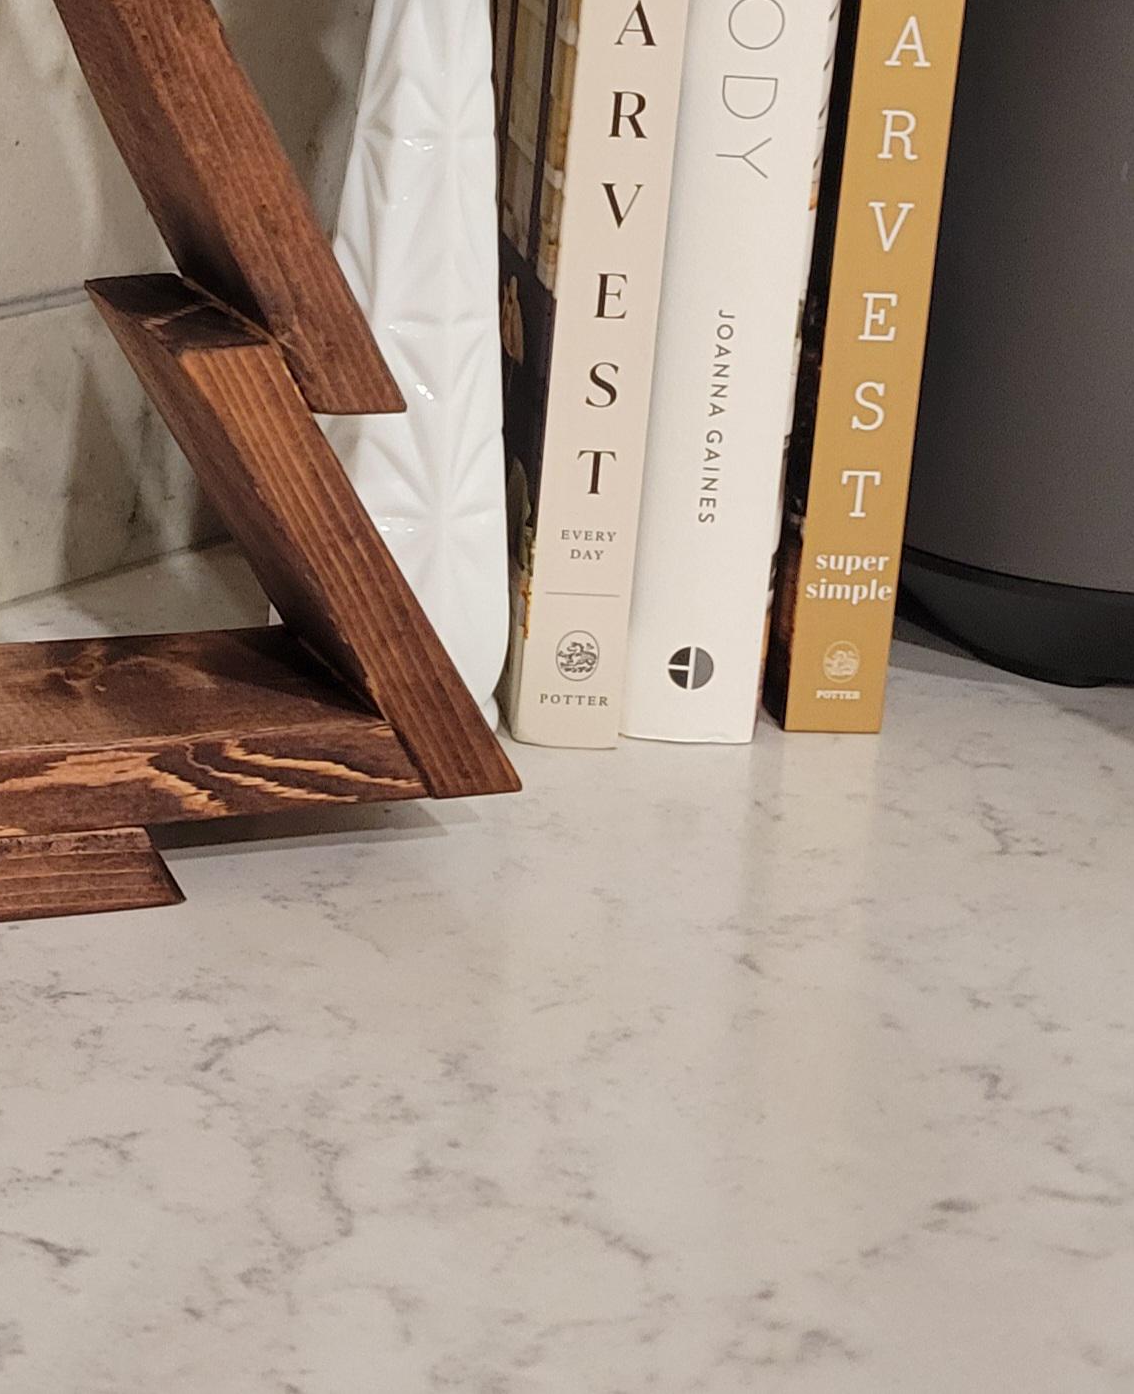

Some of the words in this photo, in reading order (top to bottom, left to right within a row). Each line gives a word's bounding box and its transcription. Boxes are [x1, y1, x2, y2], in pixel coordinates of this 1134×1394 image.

[707, 309, 736, 418] JOANNA
[697, 429, 723, 524] GAINES
[561, 529, 617, 542] EVERY
[570, 548, 604, 560] DAY
[816, 554, 889, 576] super
[805, 578, 892, 606] simple
[539, 693, 609, 706] POTTER
